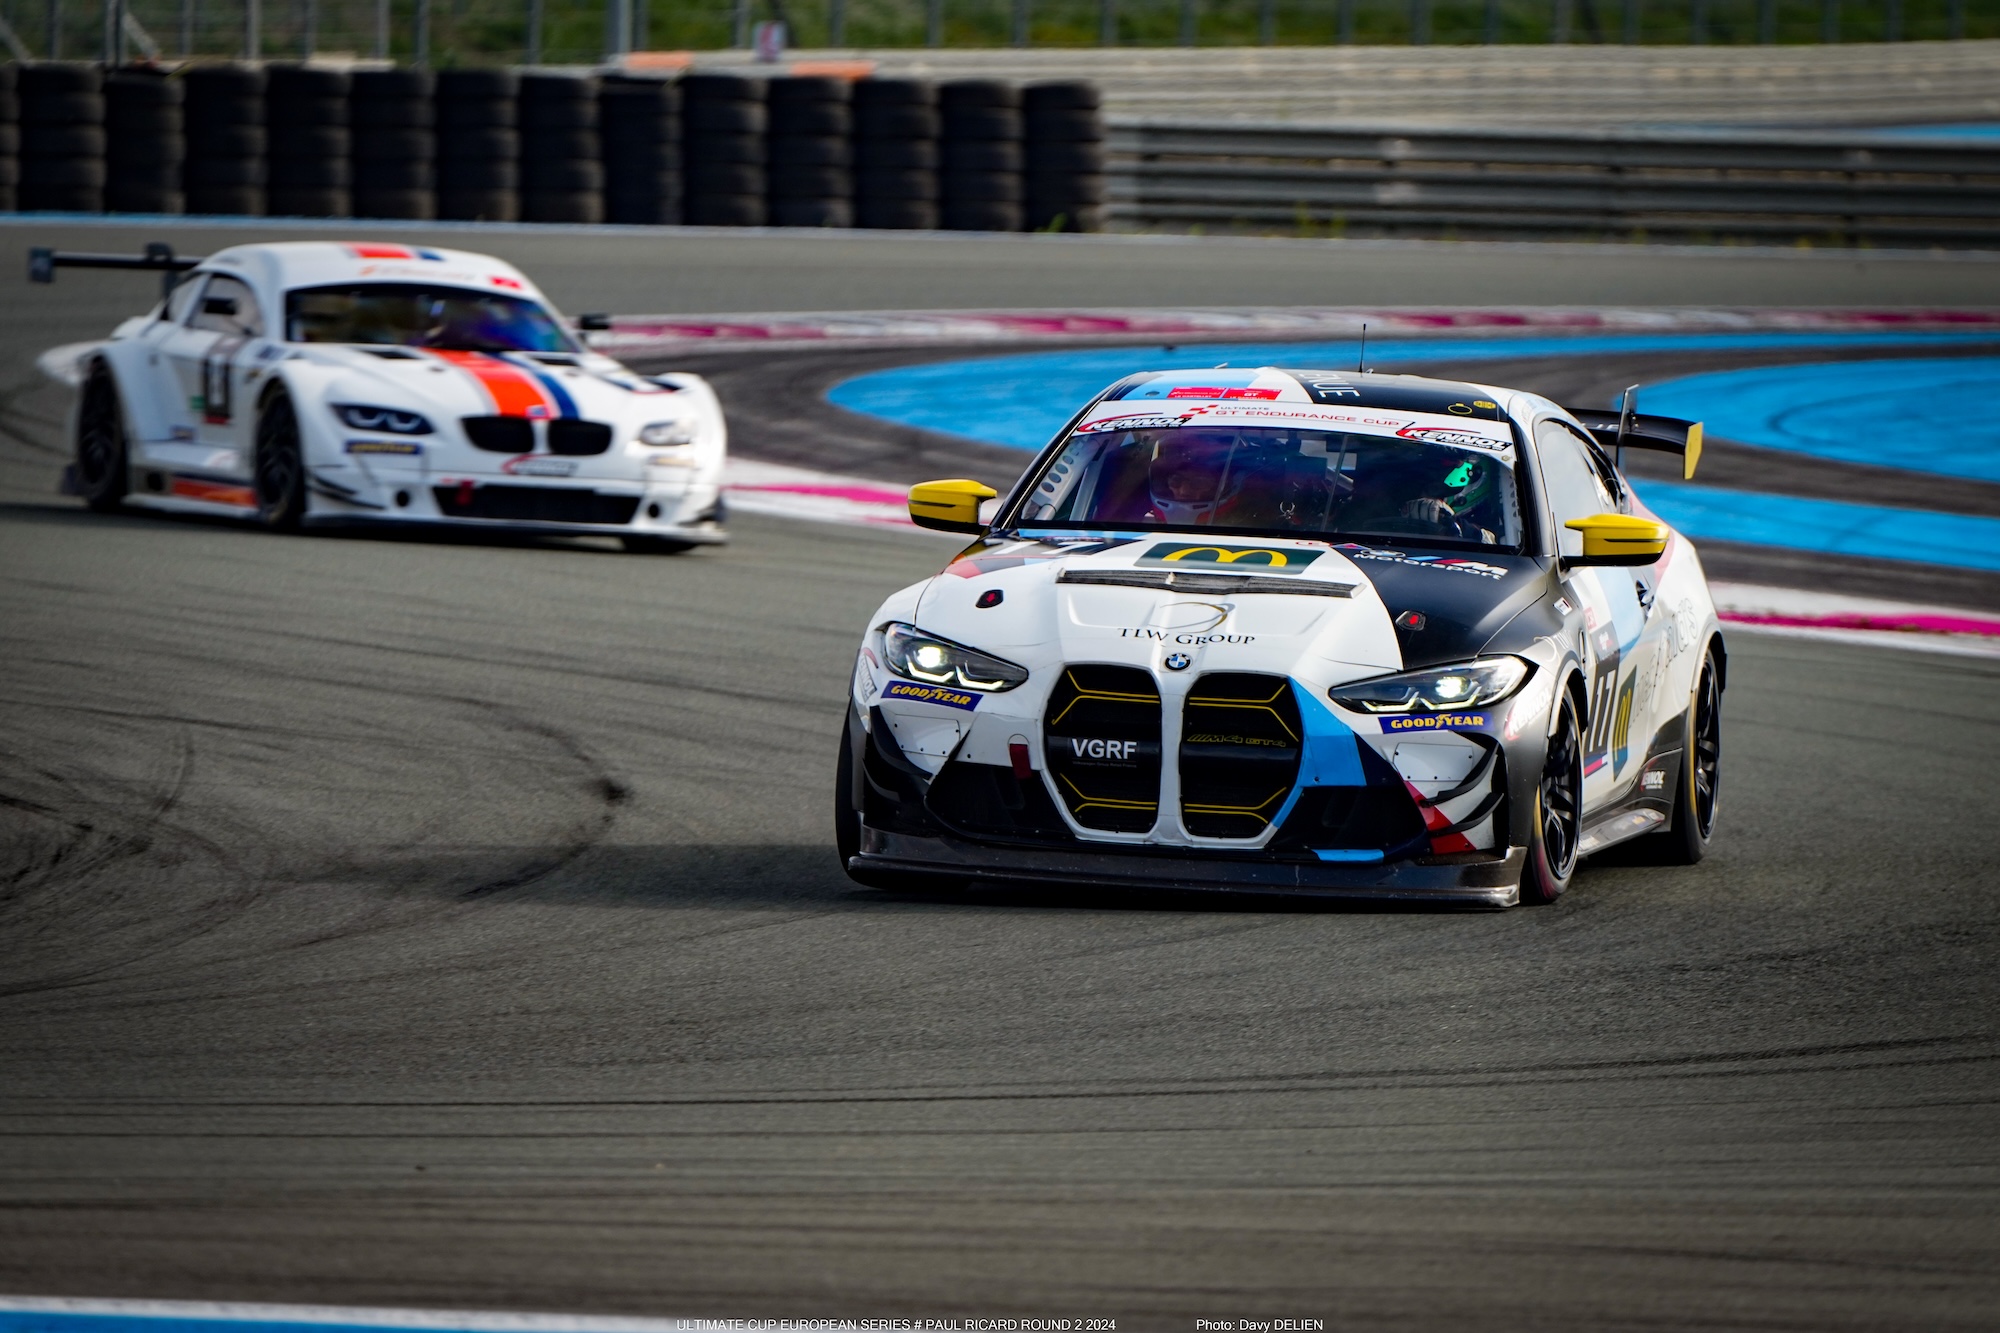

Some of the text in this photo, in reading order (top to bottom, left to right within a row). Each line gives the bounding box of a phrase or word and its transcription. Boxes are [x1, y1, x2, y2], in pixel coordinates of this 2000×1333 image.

[1084, 417, 1186, 431] KENNOL
[1245, 410, 1357, 422] ENDURANCE
[1363, 417, 1400, 427] CUP
[1403, 429, 1509, 449] KENNOL
[1353, 553, 1502, 581] Motorsport
[1117, 628, 1256, 645] TLW GROUP
[1071, 738, 1138, 760] VGRF
